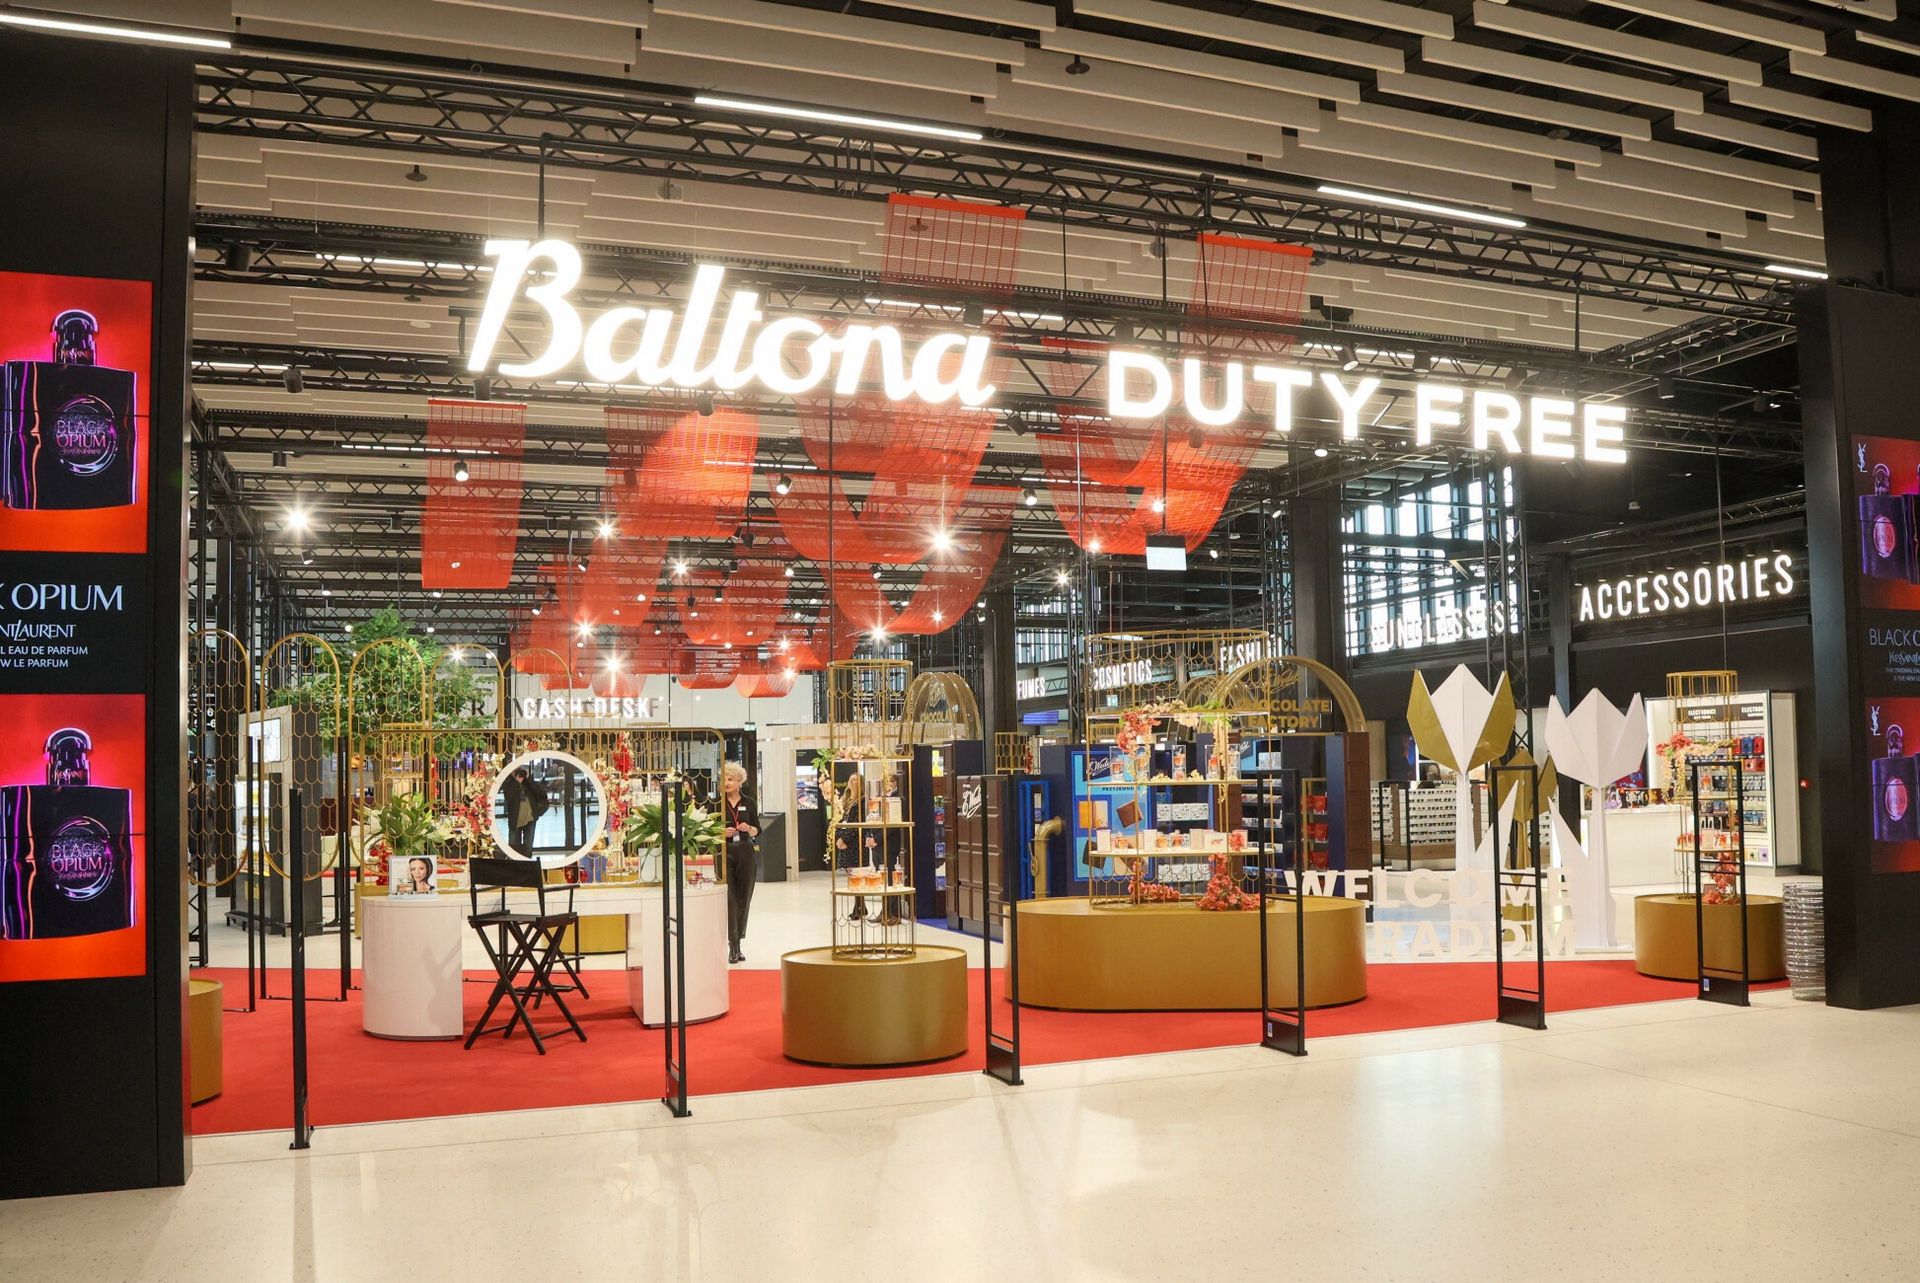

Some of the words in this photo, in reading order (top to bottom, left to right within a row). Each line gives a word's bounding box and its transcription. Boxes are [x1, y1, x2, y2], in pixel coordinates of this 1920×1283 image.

[467, 238, 997, 406] Baltona
[1107, 351, 1381, 442] DUTY
[1415, 385, 1628, 464] FREE
[57, 419, 107, 435] BLACK
[56, 433, 106, 448] OPIUM
[11, 582, 123, 611] OPIUM
[1579, 554, 1794, 622] ACCESSORIES
[1869, 628, 1912, 647] BLACK
[8, 646, 29, 655] EAU
[31, 646, 45, 655] DE
[47, 646, 88, 655] PARFUM
[13, 659, 25, 668] LE
[27, 659, 69, 668] PARFUM
[1092, 658, 1153, 691] COSMETICS
[524, 698, 578, 720] CASH
[594, 697, 649, 720] DESK
[51, 842, 102, 859] BLACK
[51, 856, 102, 873] OPIUM
[1284, 867, 1574, 909] WELCOME
[1374, 919, 1576, 958] RADOM
